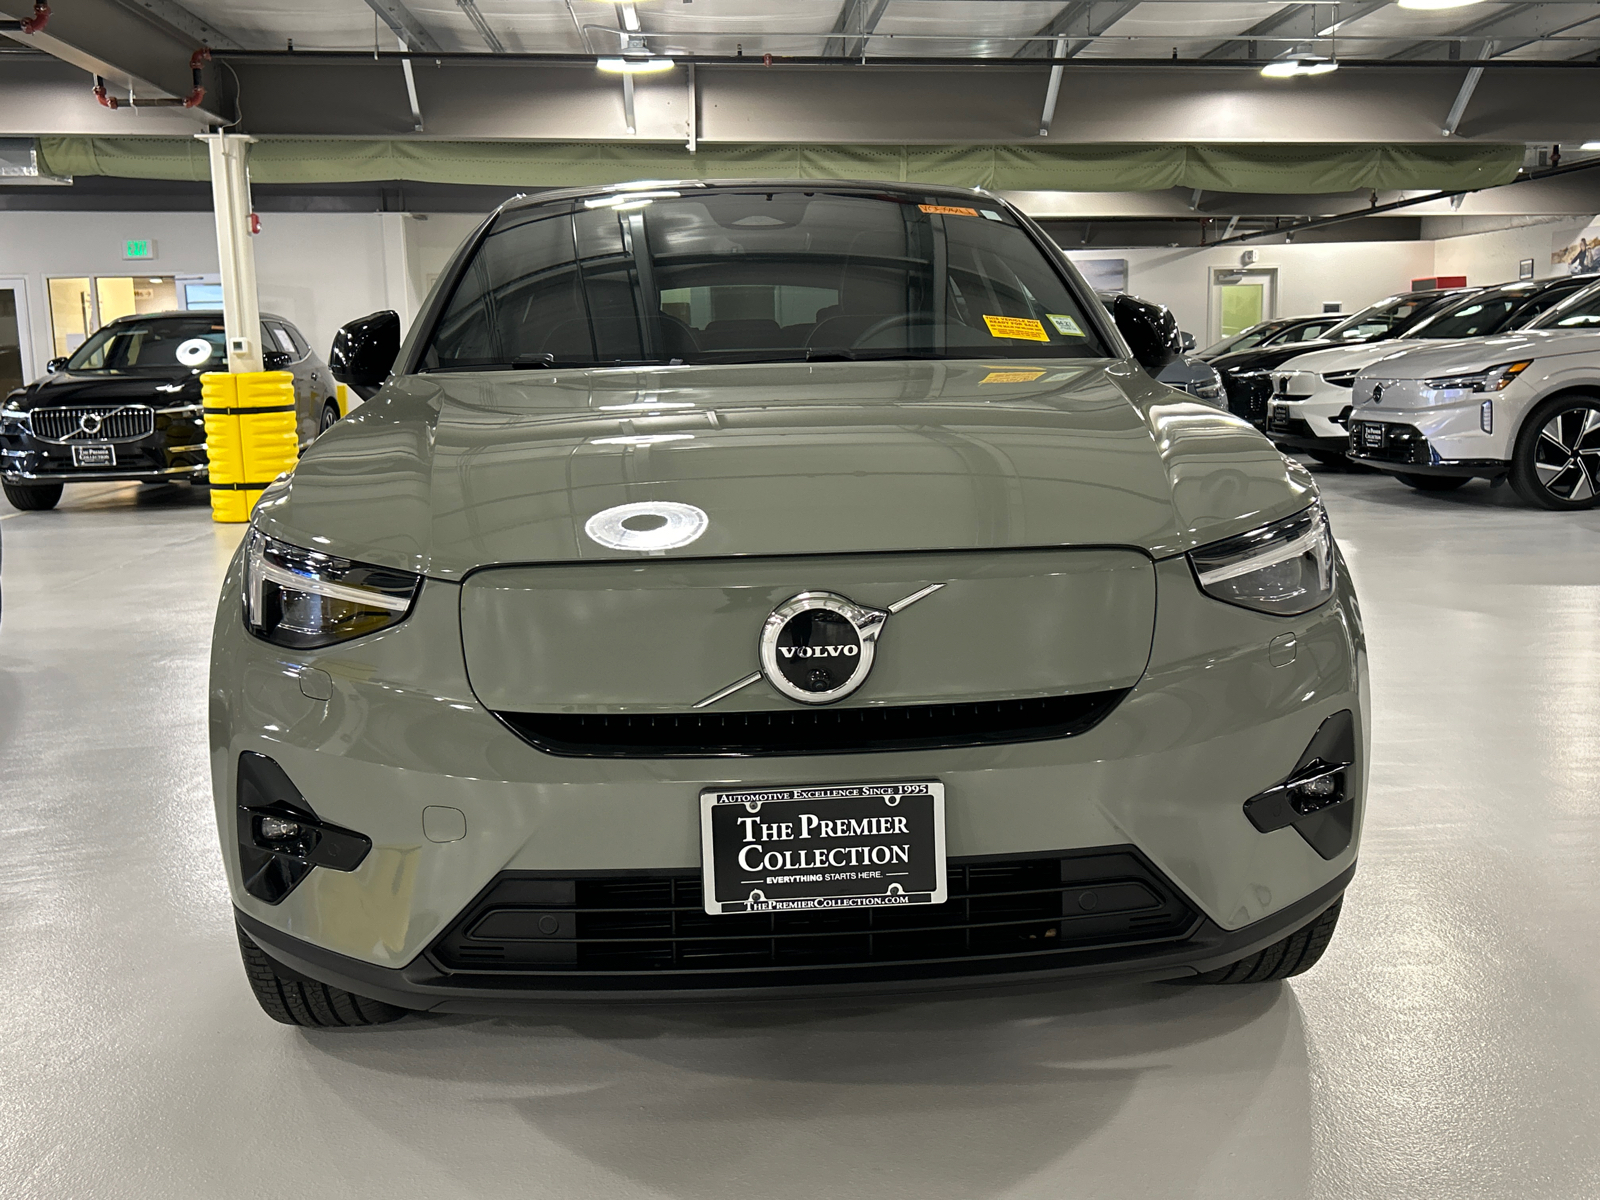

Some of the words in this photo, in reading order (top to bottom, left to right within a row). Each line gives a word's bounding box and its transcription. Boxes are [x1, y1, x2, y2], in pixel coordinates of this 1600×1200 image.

[127, 240, 147, 256] EXIT
[778, 644, 858, 658] VOLVO
[719, 791, 790, 803] AUTOMOTIVE
[793, 788, 860, 799] EXCELLENCE
[862, 786, 894, 796] SINCE
[898, 785, 927, 794] 1995
[737, 816, 794, 842] THE
[798, 814, 910, 839] PREMIER
[738, 844, 910, 872] COLLECTION
[766, 874, 823, 884] EVERYTHING
[824, 872, 857, 881] STARTS
[858, 871, 883, 879] HERE.
[744, 896, 909, 911] THEPREMIERCOLLECTION.COM
